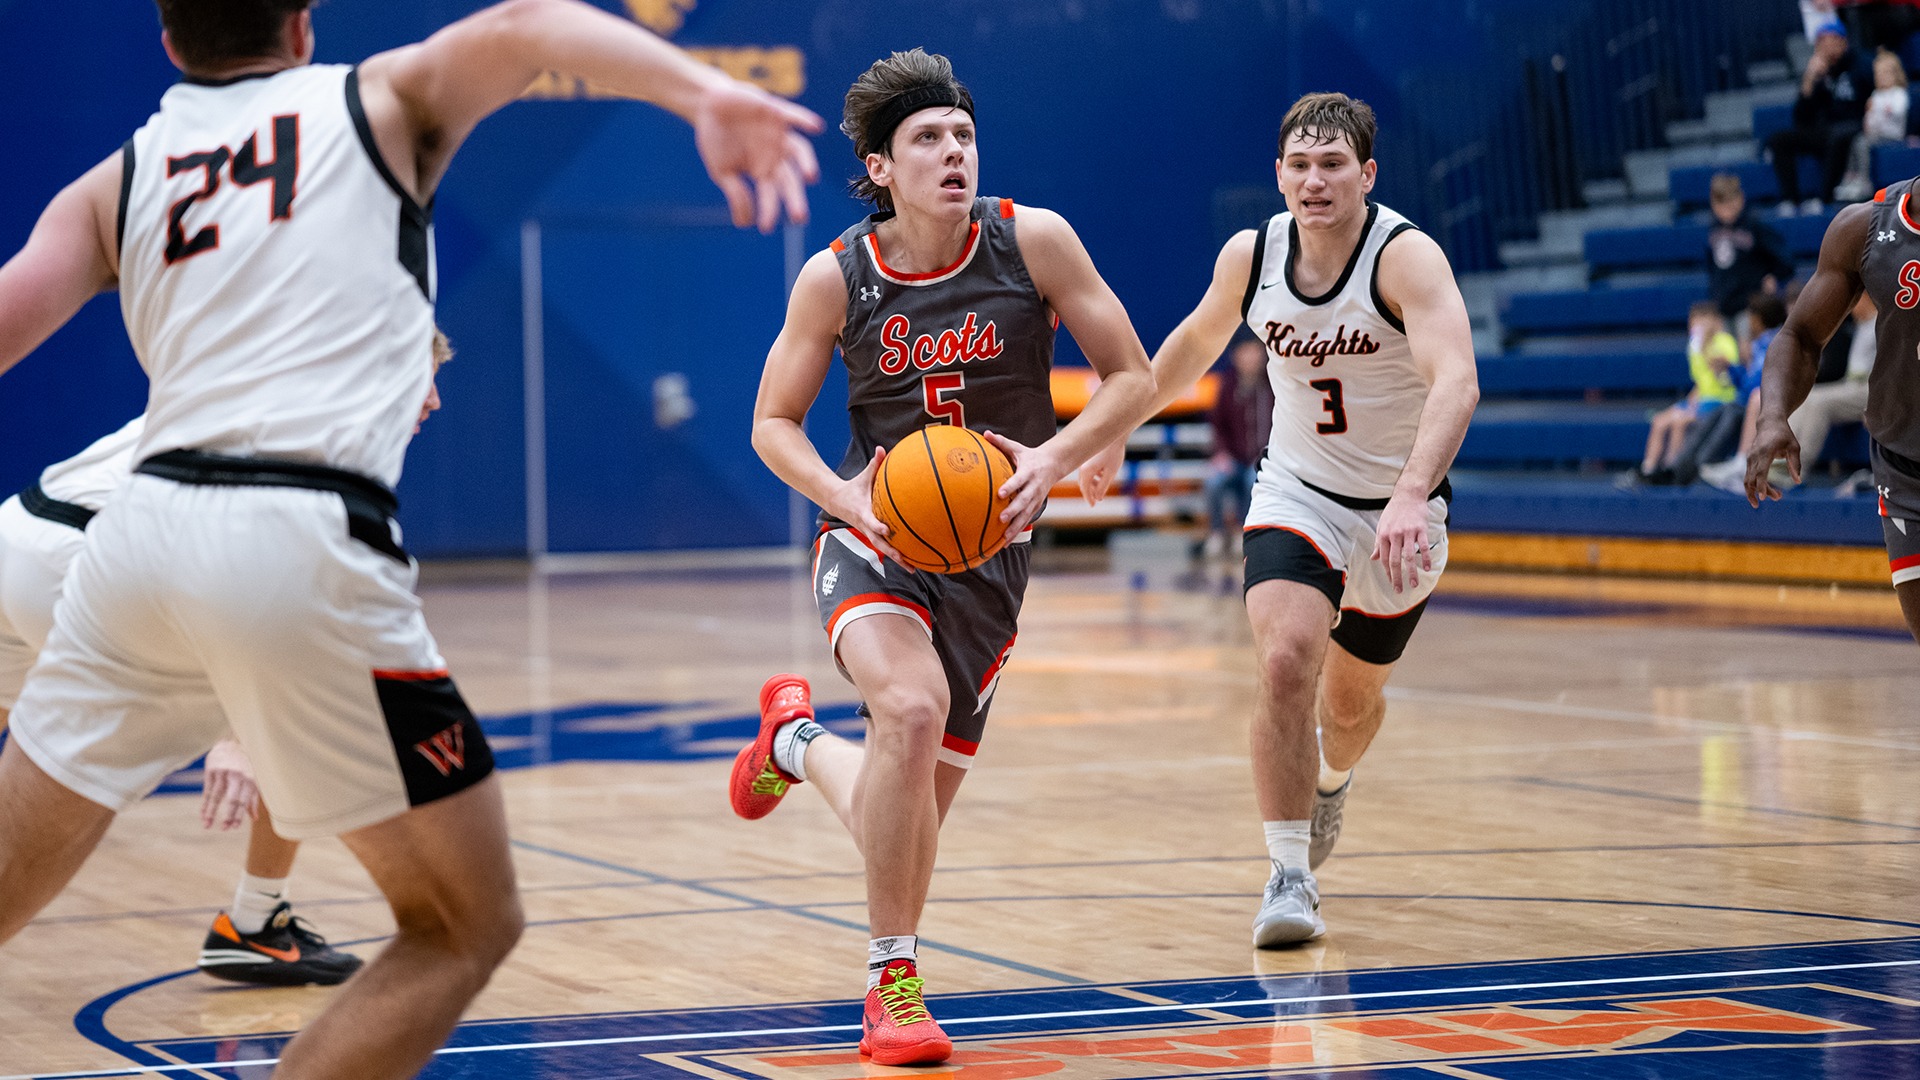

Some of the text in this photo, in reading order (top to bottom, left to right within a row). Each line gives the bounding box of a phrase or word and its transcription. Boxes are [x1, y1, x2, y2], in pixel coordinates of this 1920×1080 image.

[164, 113, 299, 267] 24
[879, 312, 1003, 375] Scots
[1265, 320, 1380, 367] Knights
[922, 371, 965, 428] 5
[1309, 378, 1348, 435] 3
[414, 721, 465, 777] W
